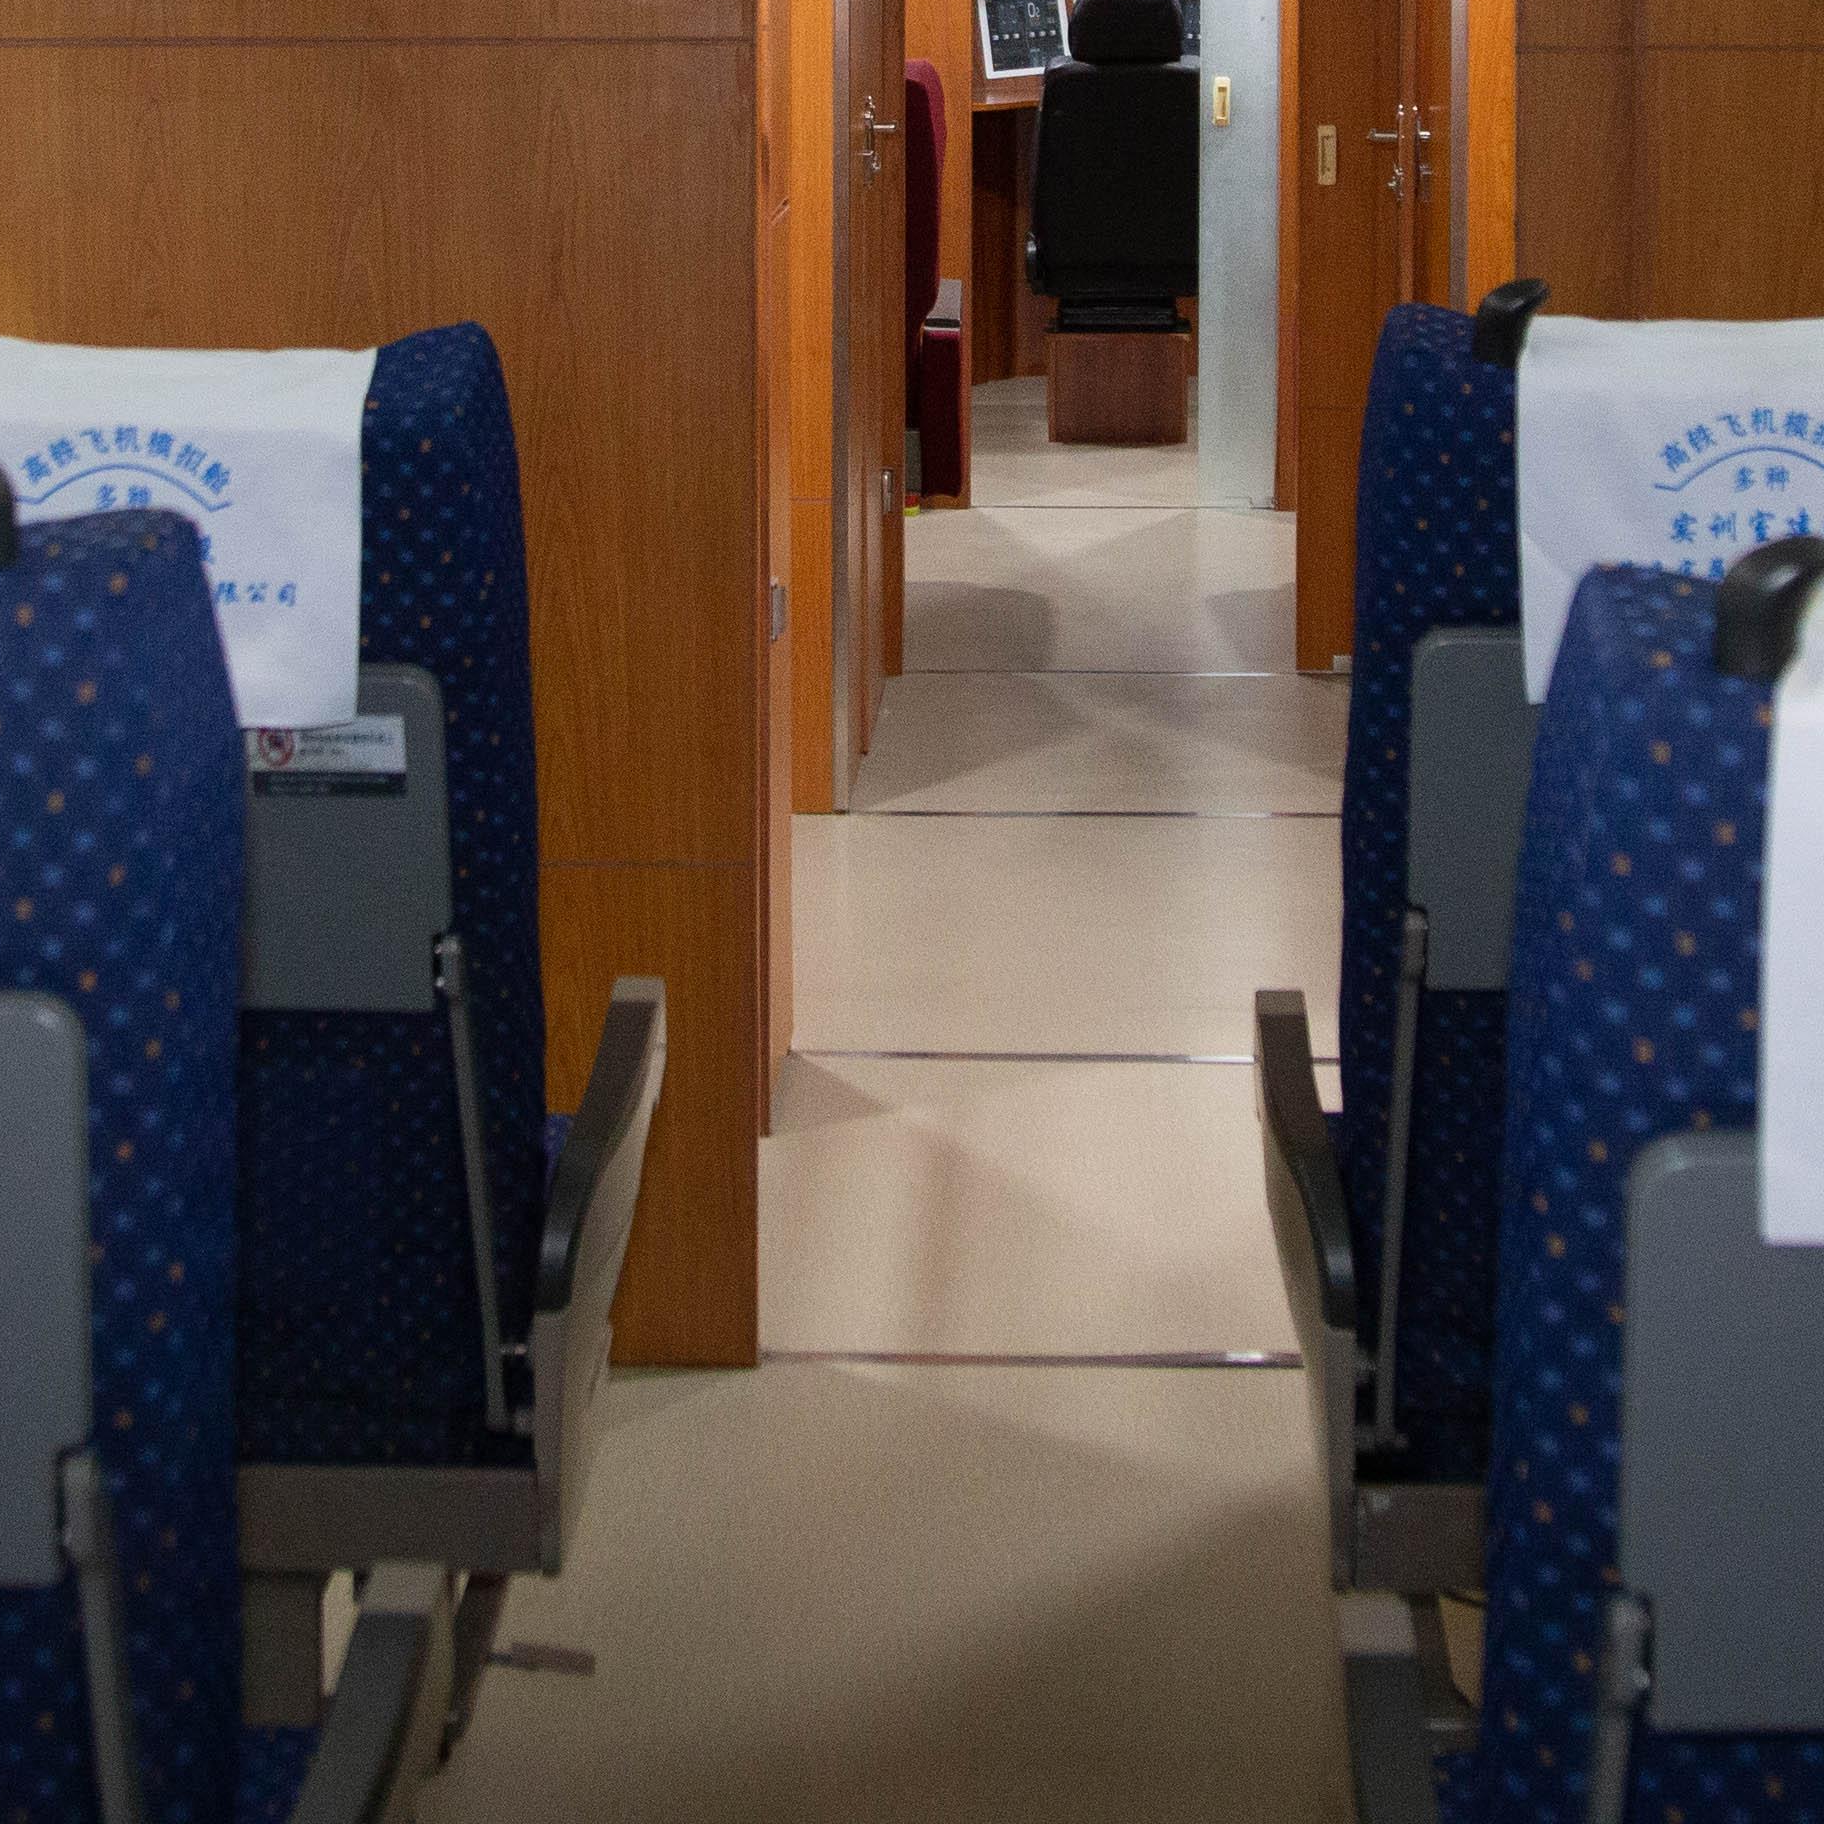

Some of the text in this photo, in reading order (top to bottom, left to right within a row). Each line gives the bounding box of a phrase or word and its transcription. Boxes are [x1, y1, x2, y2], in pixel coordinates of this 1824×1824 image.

[20, 423, 232, 497] 高铁飞机模拟舱
